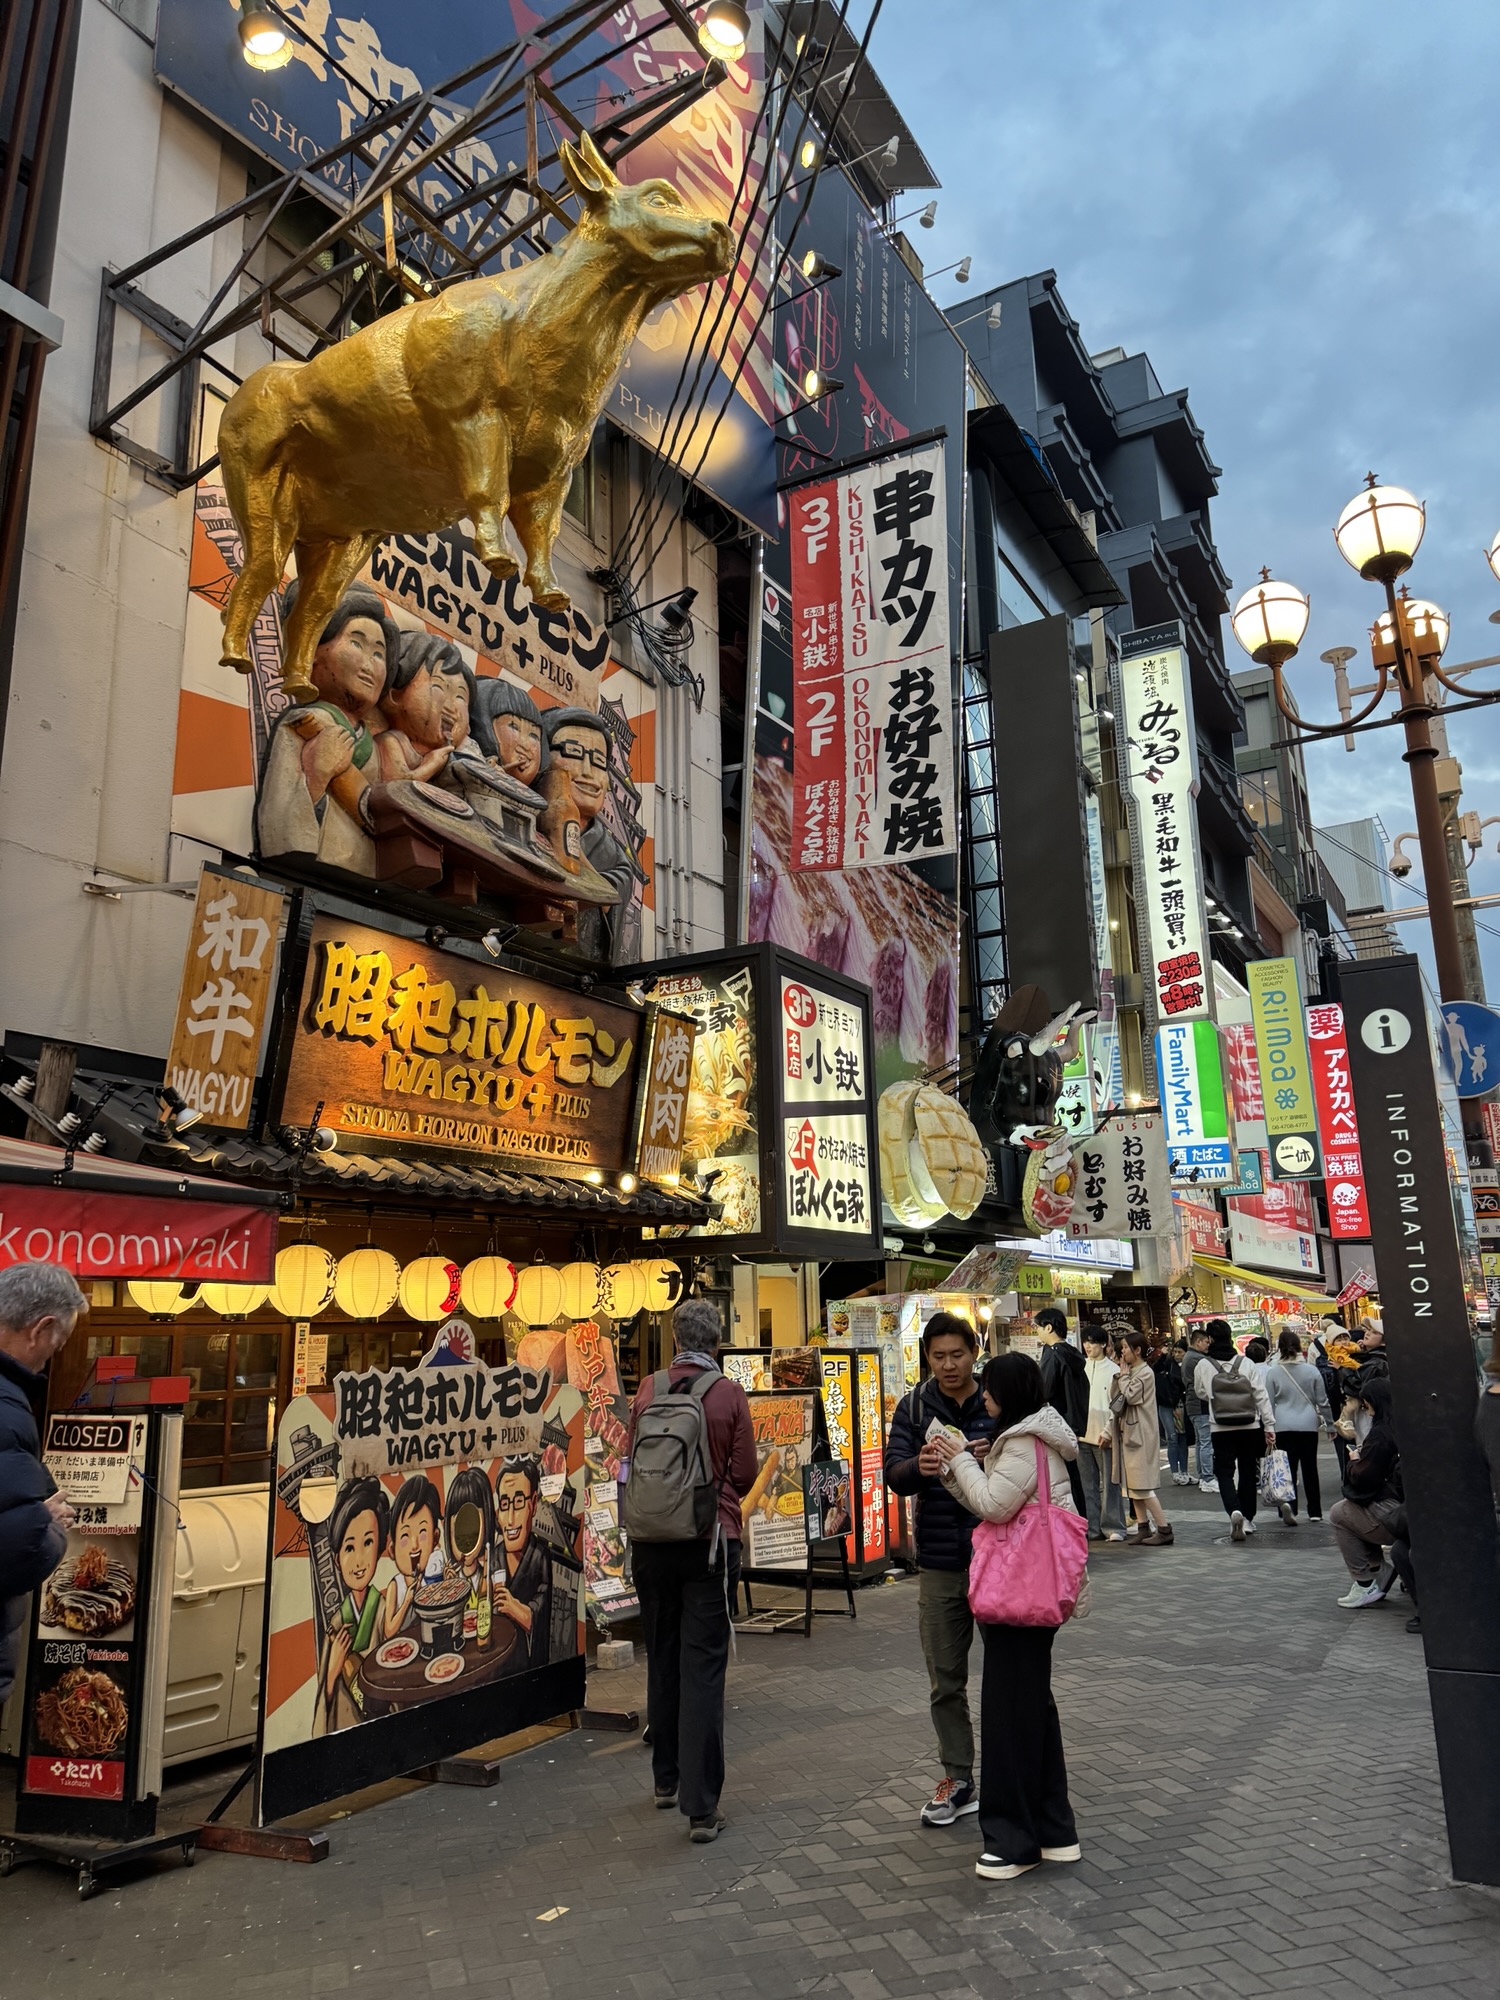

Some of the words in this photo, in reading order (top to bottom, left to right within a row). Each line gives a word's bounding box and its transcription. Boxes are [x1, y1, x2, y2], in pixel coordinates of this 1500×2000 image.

[801, 496, 831, 565] 3F
[847, 484, 868, 657] KUSHIKATSU
[873, 469, 936, 648] 串カツ
[370, 545, 505, 650] WAGYU
[539, 654, 574, 692] PLUS
[801, 618, 830, 671] 小鉄
[253, 613, 291, 720] HITAC
[829, 635, 839, 667] 串カツ
[1160, 657, 1170, 686] 炭火焼肉
[806, 692, 838, 758] 2F
[1138, 699, 1181, 765] みつる
[852, 677, 873, 859] OKONOMIYAKI
[883, 666, 943, 856] お好み焼
[801, 780, 828, 866] ぼんくら家
[1151, 792, 1187, 950] 黒毛和牛一頭買い
[186, 891, 271, 1066] 和牛
[660, 976, 702, 995] 大阪名物
[315, 940, 633, 1090] 昭和ホルモン
[788, 987, 813, 1025] 3F
[818, 1001, 841, 1032] 新世界
[841, 1006, 861, 1038] 串カツ
[1309, 1006, 1342, 1035] 薬
[788, 1031, 801, 1077] 名店
[806, 1037, 862, 1097] 小鉄
[172, 1065, 250, 1118] WAGYU
[383, 1050, 525, 1112] WAGYU
[555, 1092, 591, 1119] PLUS
[649, 1025, 691, 1145] 焼肉
[1167, 1027, 1194, 1137] FamilyMart
[1324, 1048, 1357, 1130] アカカベ
[340, 1102, 411, 1134] SHOWA
[414, 1113, 493, 1144] HORMON
[496, 1126, 551, 1154] WAGYU
[555, 1136, 591, 1160] PLUS
[788, 1125, 814, 1162] 2F
[818, 1135, 867, 1169] お好み焼き
[1172, 1148, 1187, 1164] 酒
[1191, 1147, 1224, 1162] たばこ
[1280, 1148, 1311, 1163] 一休
[1122, 1135, 1152, 1232] お好み焼
[1327, 1160, 1360, 1177] 免税
[789, 1169, 865, 1225] ぼんくら家
[1334, 1215, 1363, 1224] Tax-free
[1335, 1207, 1360, 1217] Japan.
[1386, 1093, 1433, 1318] INFORMATION
[0, 1213, 251, 1278] konomiyaki
[1058, 1233, 1093, 1258] FamilyMart
[1072, 1222, 1089, 1235] B1
[1340, 1223, 1359, 1232] Shop
[571, 1317, 615, 1422] 神戸牛
[823, 1360, 848, 1377] 2F
[338, 1365, 551, 1440] 昭和ホルモン
[824, 1379, 851, 1460] お好み焼き
[44, 1455, 63, 1465] 2F/3F
[65, 1456, 126, 1467] ただいま準備中
[53, 1424, 124, 1448] CLOSED
[386, 1428, 477, 1466] WAGYU
[501, 1425, 526, 1445] PLUS
[80, 1524, 138, 1535] Okonomiyaki
[872, 1487, 884, 1547] 串かつ
[44, 1642, 87, 1664] 焼そば
[86, 1648, 129, 1661] Yakisoba
[60, 1778, 91, 1788] Takohachi
